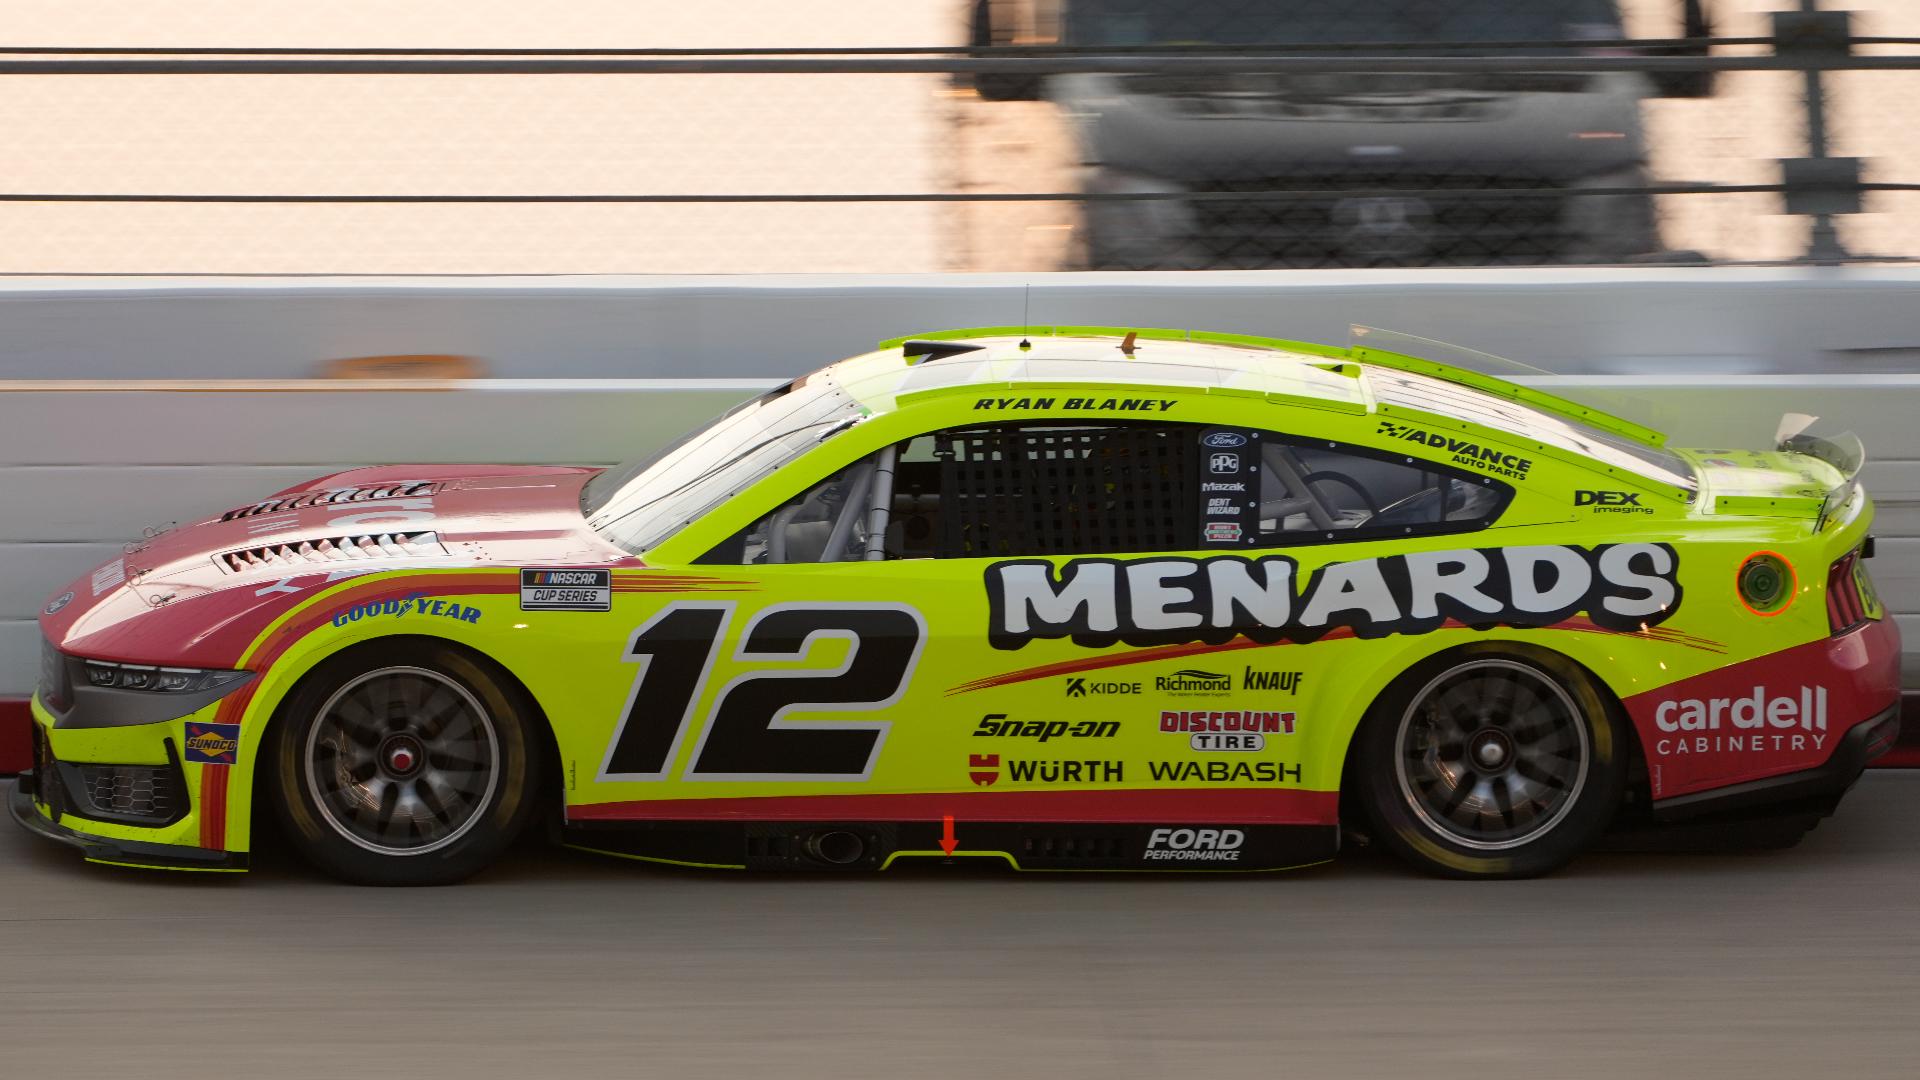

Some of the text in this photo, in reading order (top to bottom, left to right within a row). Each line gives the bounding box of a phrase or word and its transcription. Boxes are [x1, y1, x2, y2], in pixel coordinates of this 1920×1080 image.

[973, 398, 1178, 412] RYAN BLANEY
[1210, 434, 1239, 445] Ford
[1405, 430, 1533, 473] ADVANCE
[1212, 455, 1237, 471] PPG
[1452, 454, 1527, 481] AUTO PARTS
[1202, 482, 1246, 492] Mazak
[1208, 498, 1232, 507] DENT
[1574, 490, 1642, 506] DEX
[1207, 506, 1241, 515] WIZARD
[1593, 506, 1655, 515] imaging
[549, 573, 598, 585] NASCAR
[533, 589, 598, 602] CUP SERIES
[998, 542, 1676, 636] MENARDS
[332, 593, 482, 627] GOODYEAR
[1090, 665, 1304, 696] KIDDE Richmond KNAUF
[594, 600, 929, 782] 12
[1655, 685, 1828, 732] cardell
[972, 713, 1122, 743] Snap-on
[1159, 710, 1296, 734] DISCOUNT
[187, 737, 238, 751] SUNOCO
[1197, 735, 1256, 749] TIRE
[1656, 734, 1827, 755] CABINETRY
[1008, 759, 1302, 783] WÜRTH WABASH
[1147, 828, 1245, 850] FORD
[1143, 849, 1241, 861] PERFORMANCE
